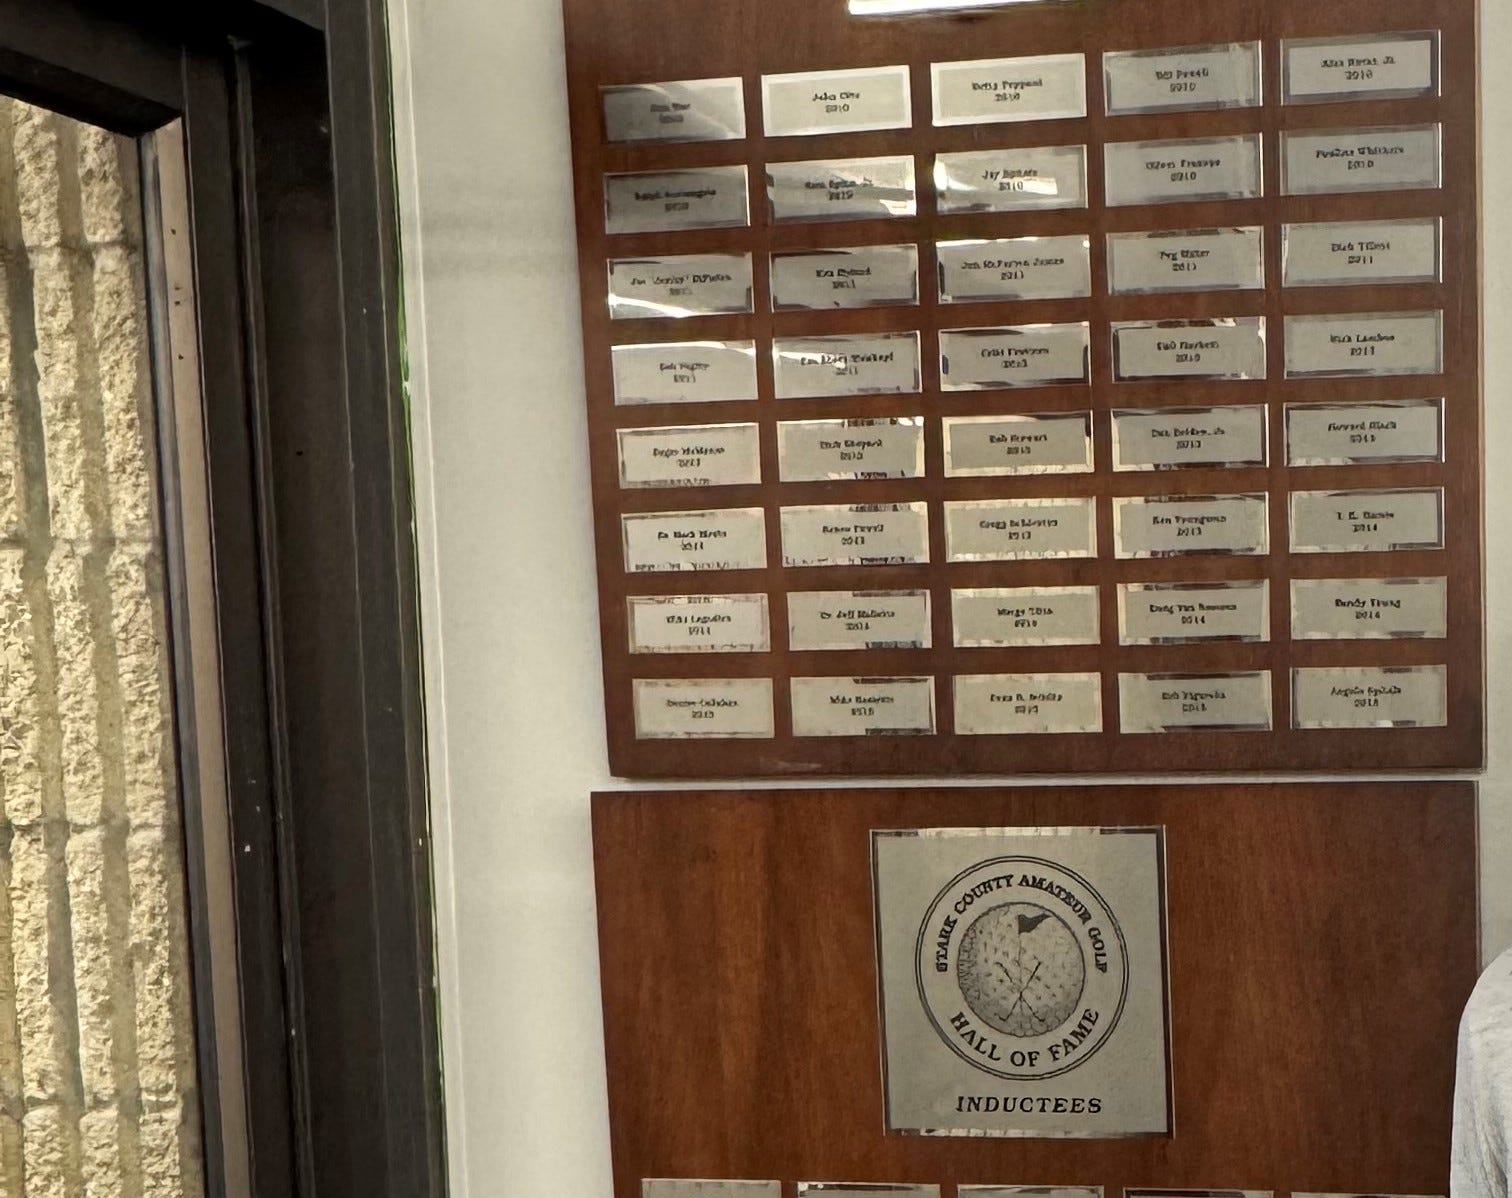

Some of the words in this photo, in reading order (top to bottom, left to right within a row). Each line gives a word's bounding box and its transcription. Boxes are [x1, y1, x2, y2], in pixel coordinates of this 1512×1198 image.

[936, 915, 957, 973] STARK
[954, 874, 1014, 915] COUNTY
[1018, 874, 1093, 925] AMATEUR
[1089, 926, 1108, 974] GOLF
[950, 1011, 1001, 1061] HALL
[1010, 1050, 1040, 1067] OF
[1048, 1008, 1099, 1061] FAME
[955, 1096, 1102, 1113] INDUCTEES
